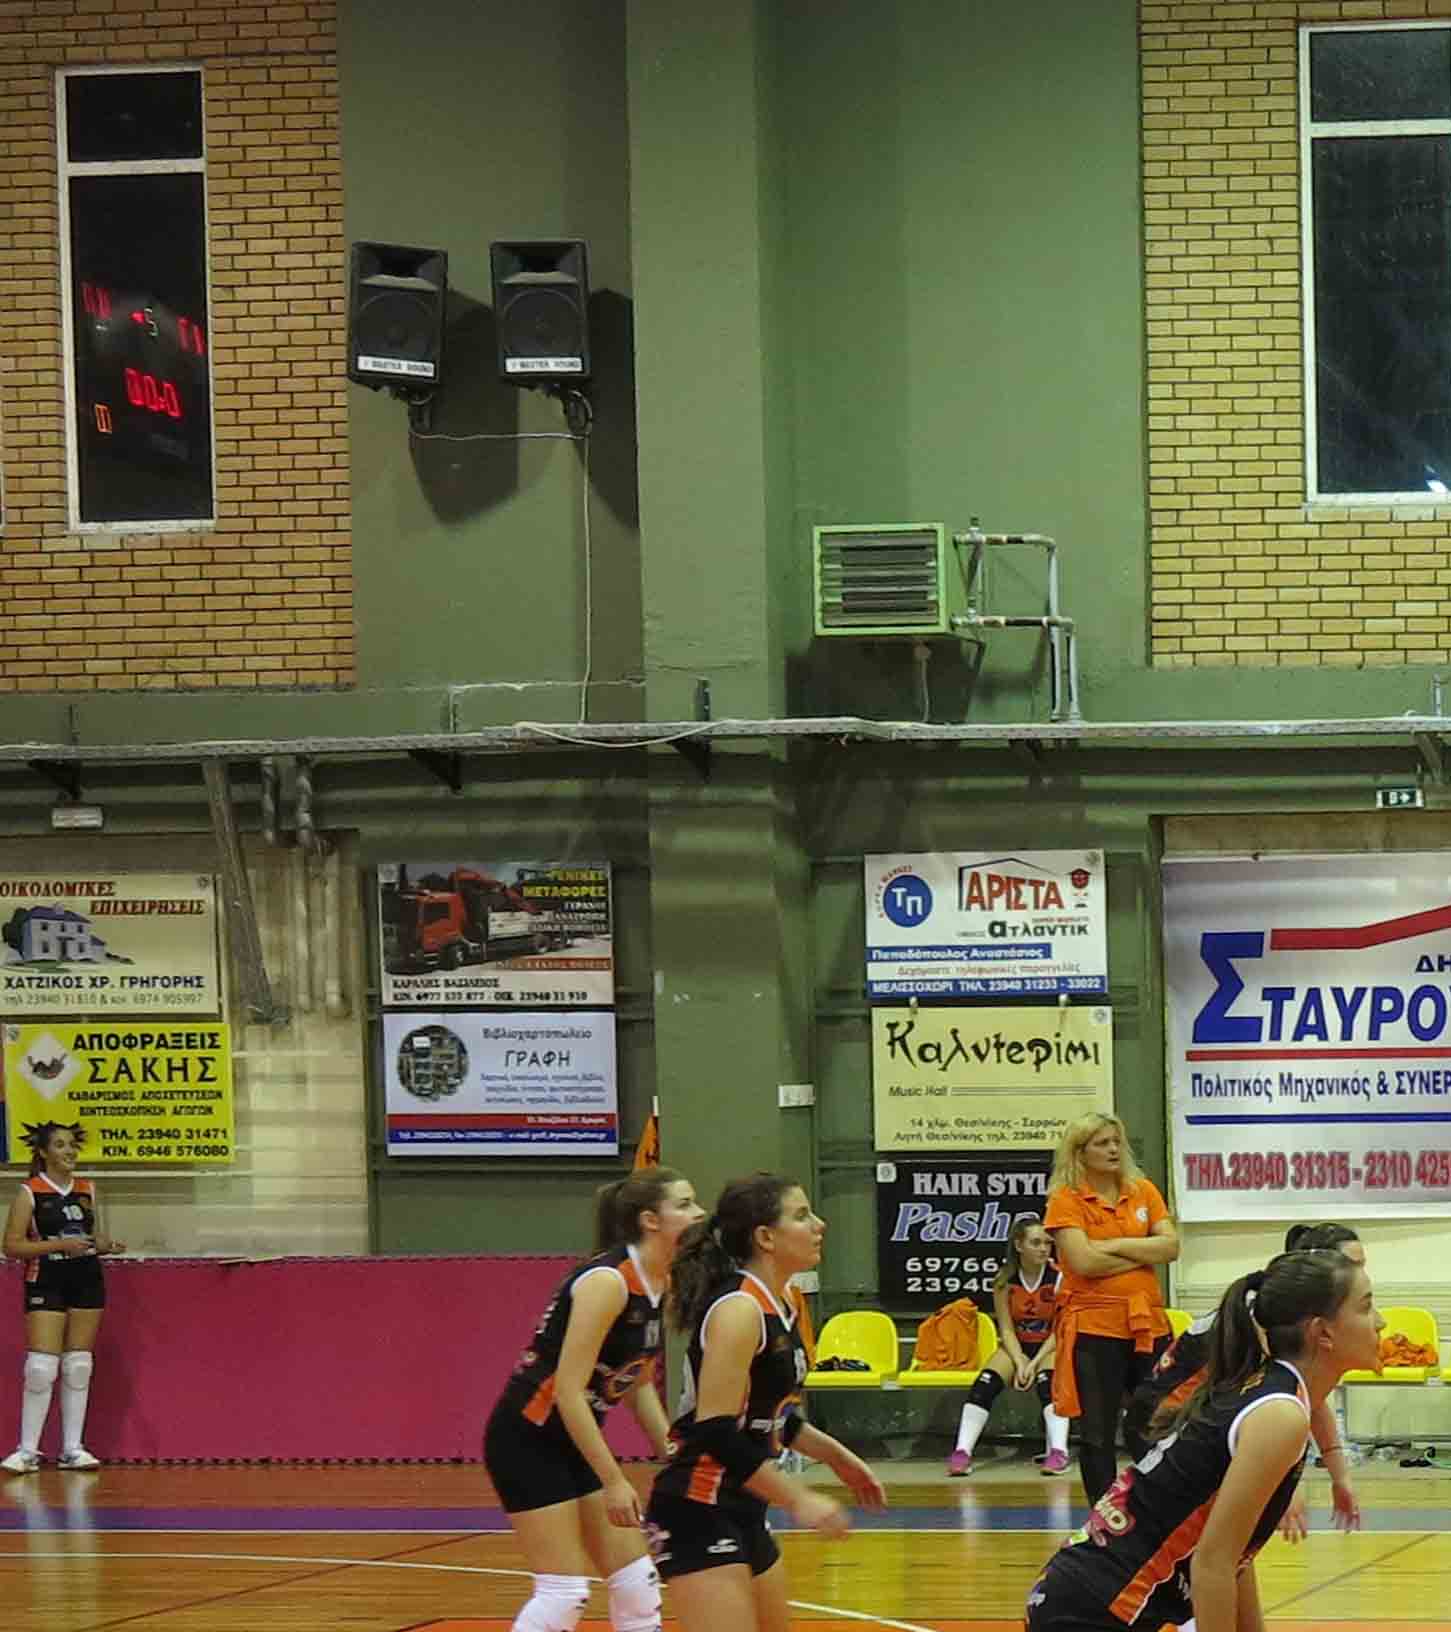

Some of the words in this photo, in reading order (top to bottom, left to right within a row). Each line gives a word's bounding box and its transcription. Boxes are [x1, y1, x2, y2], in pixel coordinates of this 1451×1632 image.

[965, 871, 1065, 911] ΑΡΙΣΤΑ
[4, 976, 84, 989] ΧΑΤΖΙΚΟΣ
[89, 976, 115, 989] ΧΡ.
[120, 976, 205, 989] ΓΡΗΓΟΡΗΣ
[73, 1033, 221, 1050] ΑΠΟΦΡΑΞΕΙΣ
[504, 1050, 570, 1067] ΓΡΑΦΗ
[88, 1057, 218, 1084] ΣΑΚΗΣ
[1191, 1072, 1274, 1102] Πολιτικός
[1278, 1069, 1371, 1102] Μηχανικός
[1376, 1072, 1391, 1095] &
[101, 1128, 133, 1140] ΤΗΛ.
[137, 1128, 181, 1140] 23940
[185, 1128, 228, 1140] 31471
[1363, 1151, 1411, 1188] 2310
[913, 1172, 981, 1195] HAIR
[987, 1172, 1048, 1196] STYL
[905, 1256, 1007, 1273] 69766
